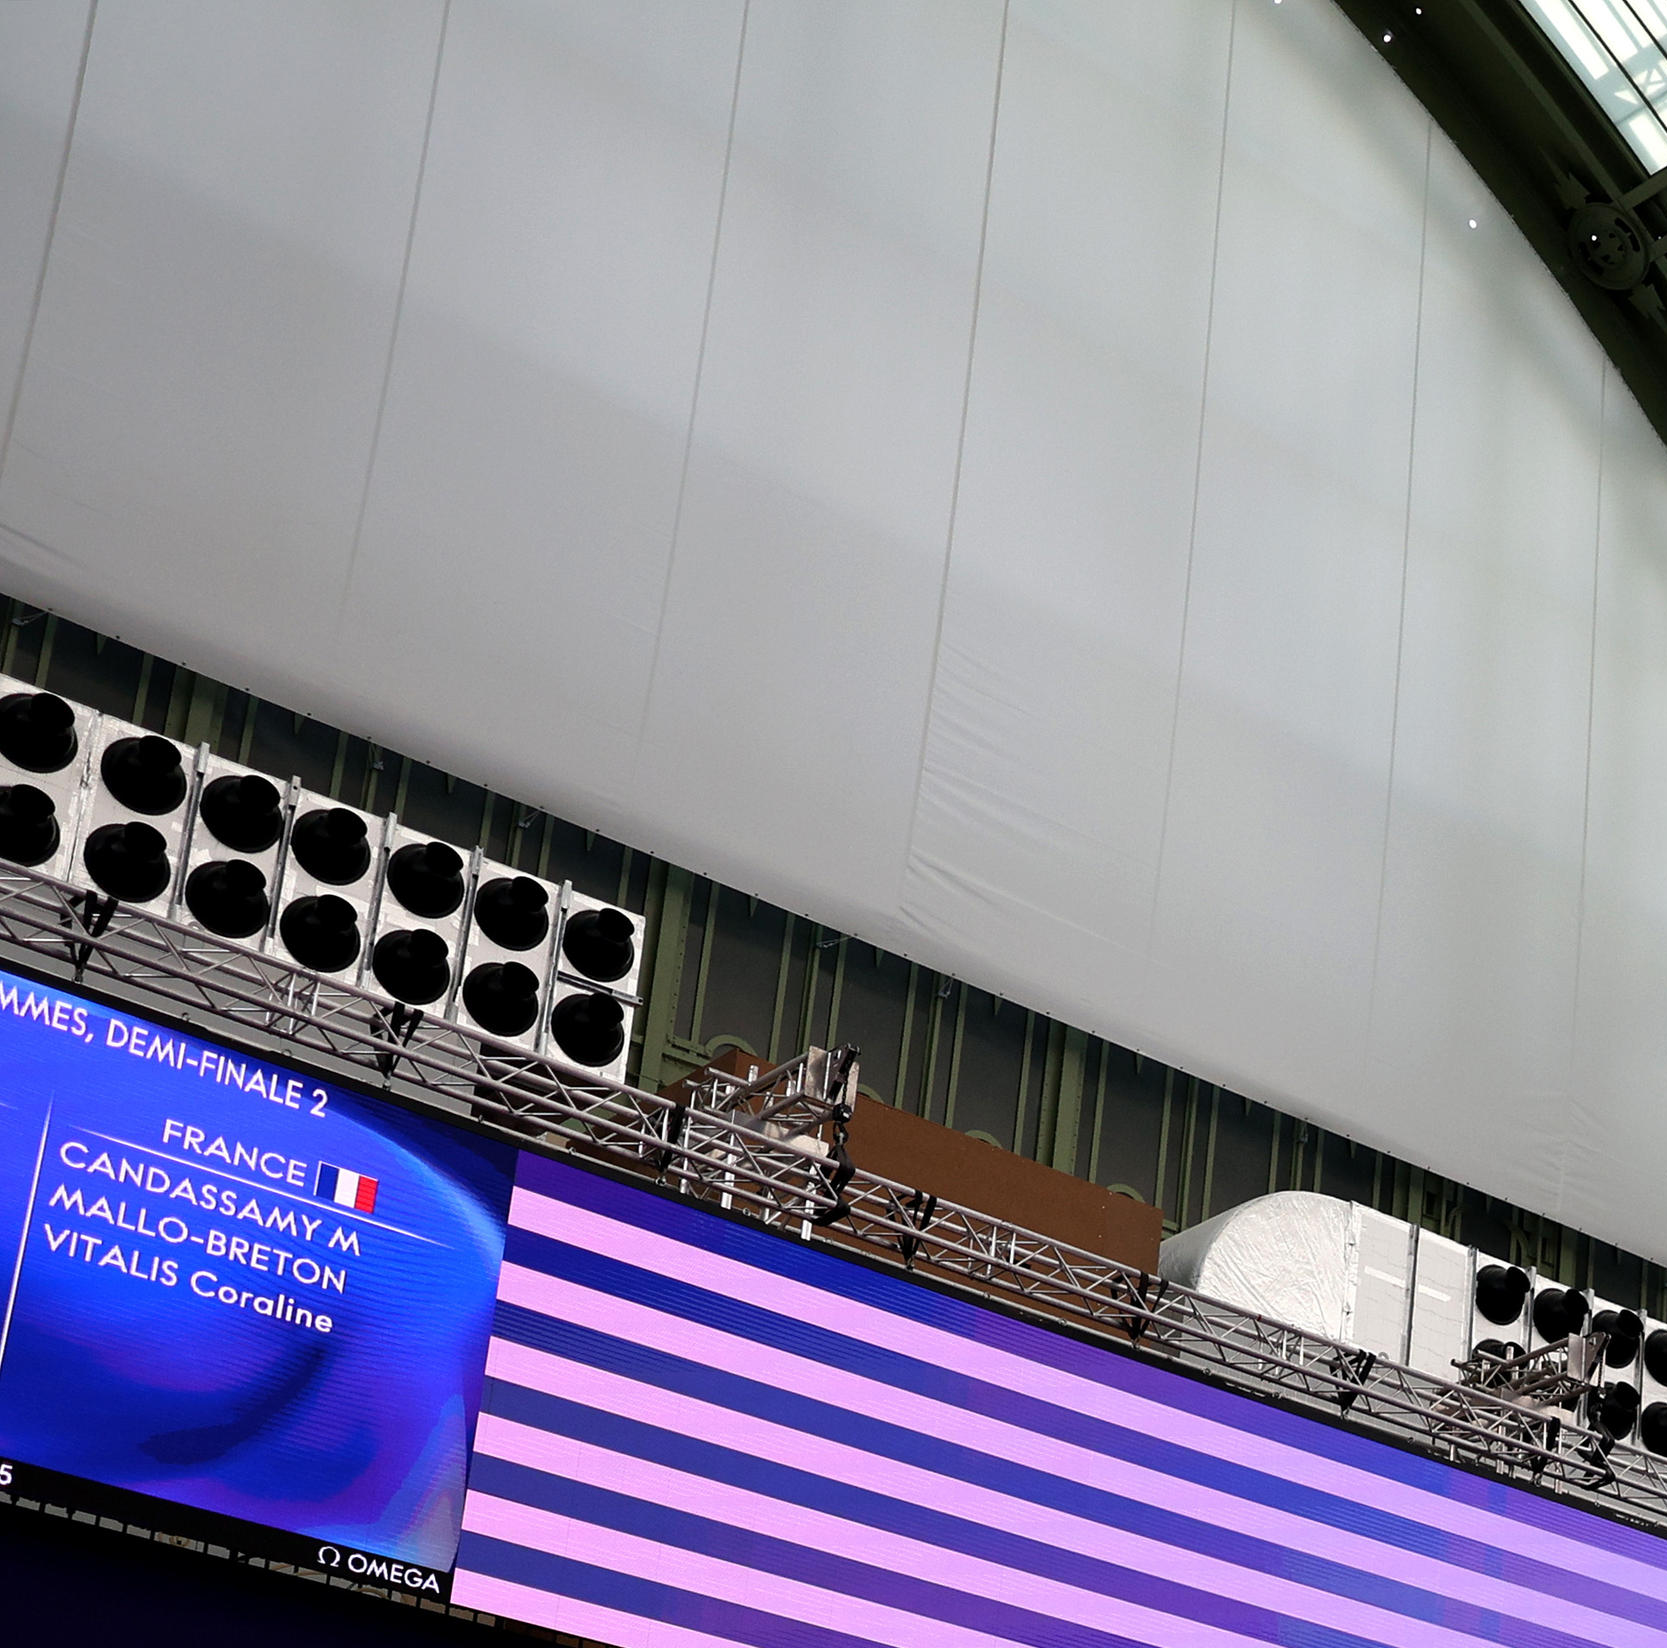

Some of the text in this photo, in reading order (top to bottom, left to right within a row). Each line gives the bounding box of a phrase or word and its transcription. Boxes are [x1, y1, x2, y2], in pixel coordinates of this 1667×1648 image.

[106, 1018, 304, 1109] DEMI-FINALE
[310, 1089, 328, 1117] 2
[60, 1141, 361, 1257] CANDASSAMY M
[162, 1118, 308, 1187] FRANCE
[44, 1223, 333, 1333] VITALIS Coraline
[49, 1183, 347, 1294] MALLO-BRETON
[348, 1553, 441, 1594] OMEGA
